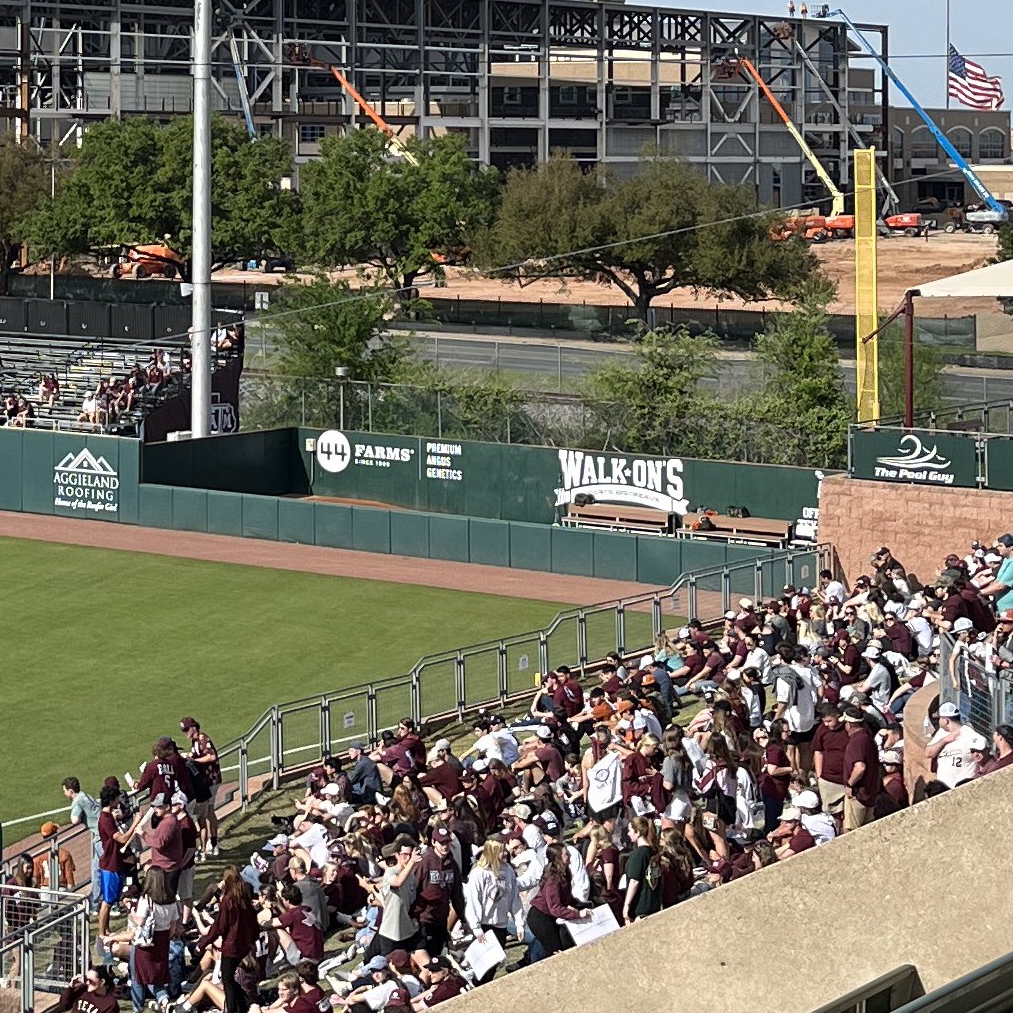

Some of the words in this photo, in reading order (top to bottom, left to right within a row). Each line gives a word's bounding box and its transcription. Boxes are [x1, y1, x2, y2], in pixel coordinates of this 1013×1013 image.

[320, 442, 347, 462] 44
[354, 444, 411, 461] FARMS
[426, 442, 462, 456] PREMIUM
[426, 455, 451, 467] ANGUS
[53, 472, 119, 489] AGGIELAND
[426, 468, 463, 481] GENETICS
[874, 467, 897, 478] The
[899, 468, 927, 480] Pool
[928, 471, 955, 484] Guy
[58, 486, 114, 501] ROOFING
[952, 757, 962, 767] 12
